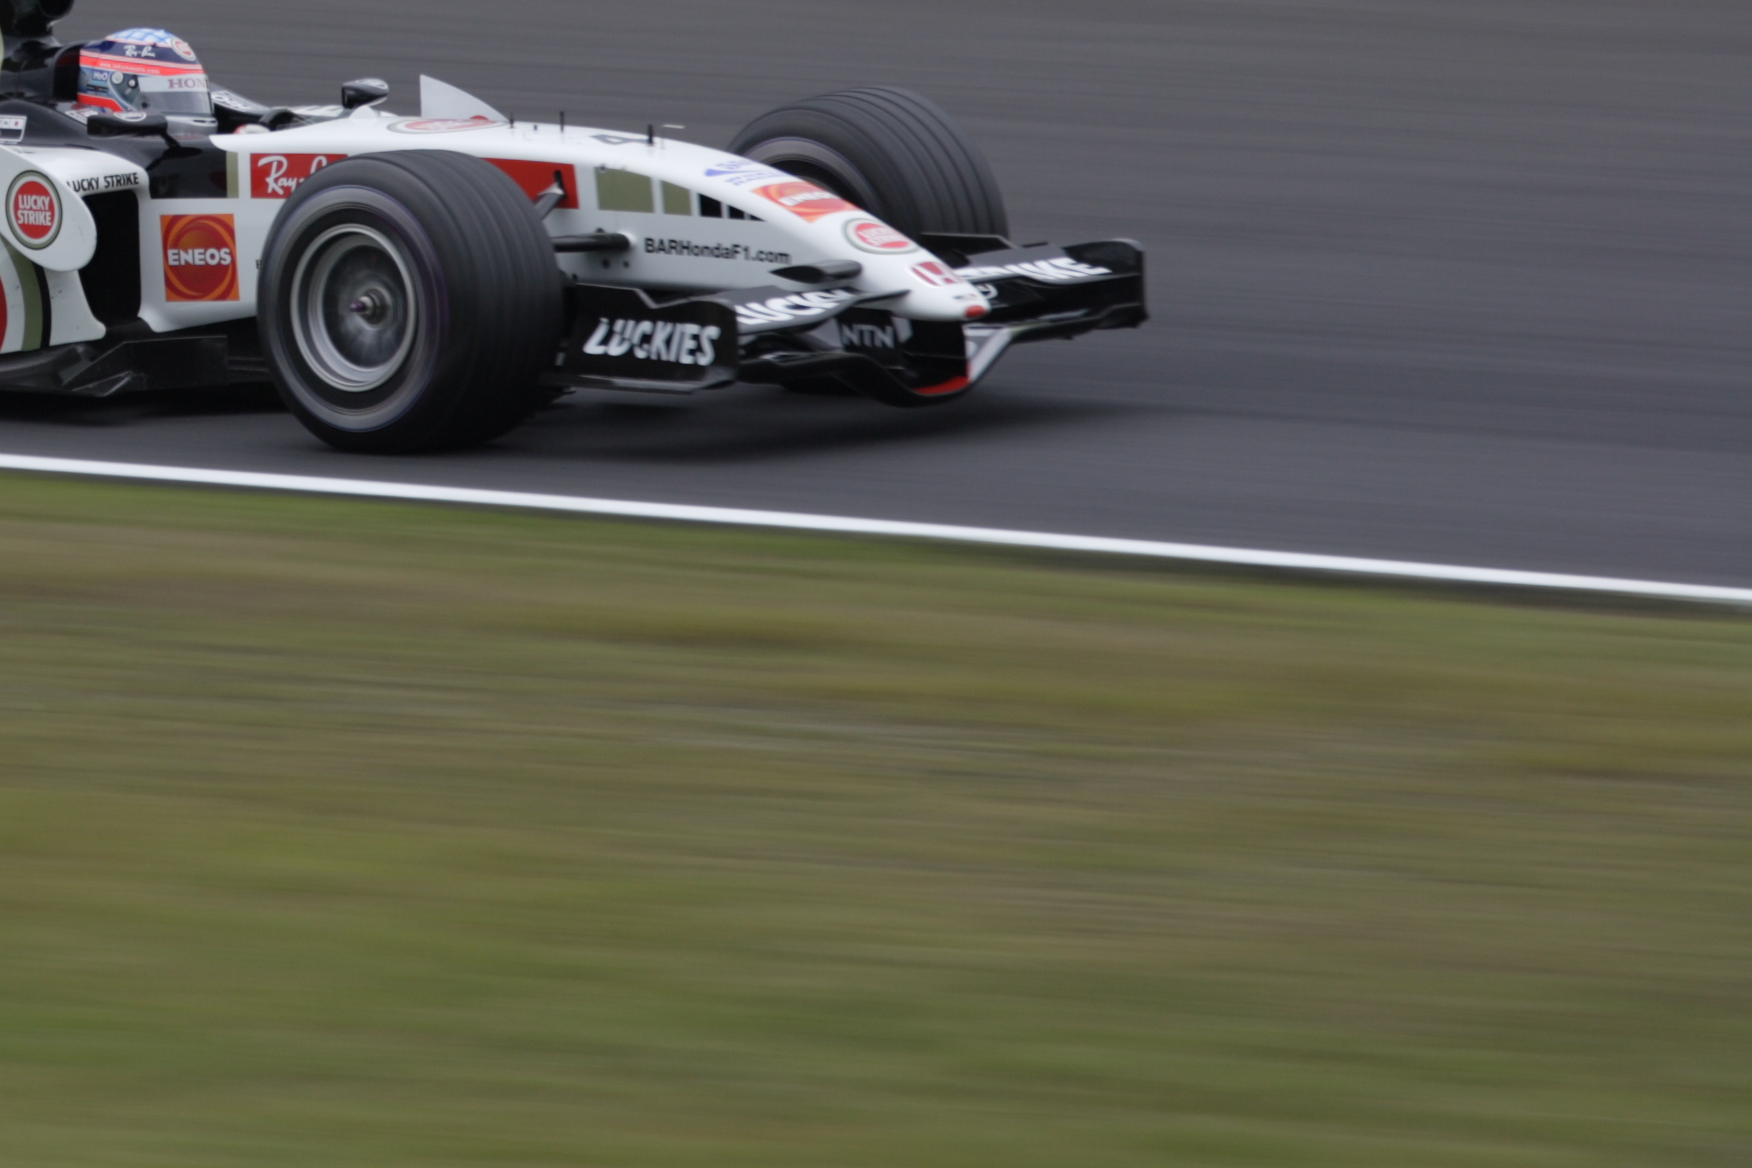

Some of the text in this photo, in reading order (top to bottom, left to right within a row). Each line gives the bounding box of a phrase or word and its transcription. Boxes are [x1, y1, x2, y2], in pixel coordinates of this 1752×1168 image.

[168, 78, 207, 90] HON
[103, 172, 140, 189] STRIKE
[258, 155, 328, 195] Ray-
[17, 194, 50, 211] LUCKY
[16, 209, 52, 226] STRIKE
[167, 247, 232, 267] ENEOS
[644, 237, 792, 265] BARHondaF1.com
[582, 317, 722, 367] LUCKIES
[841, 323, 896, 350] NTN
